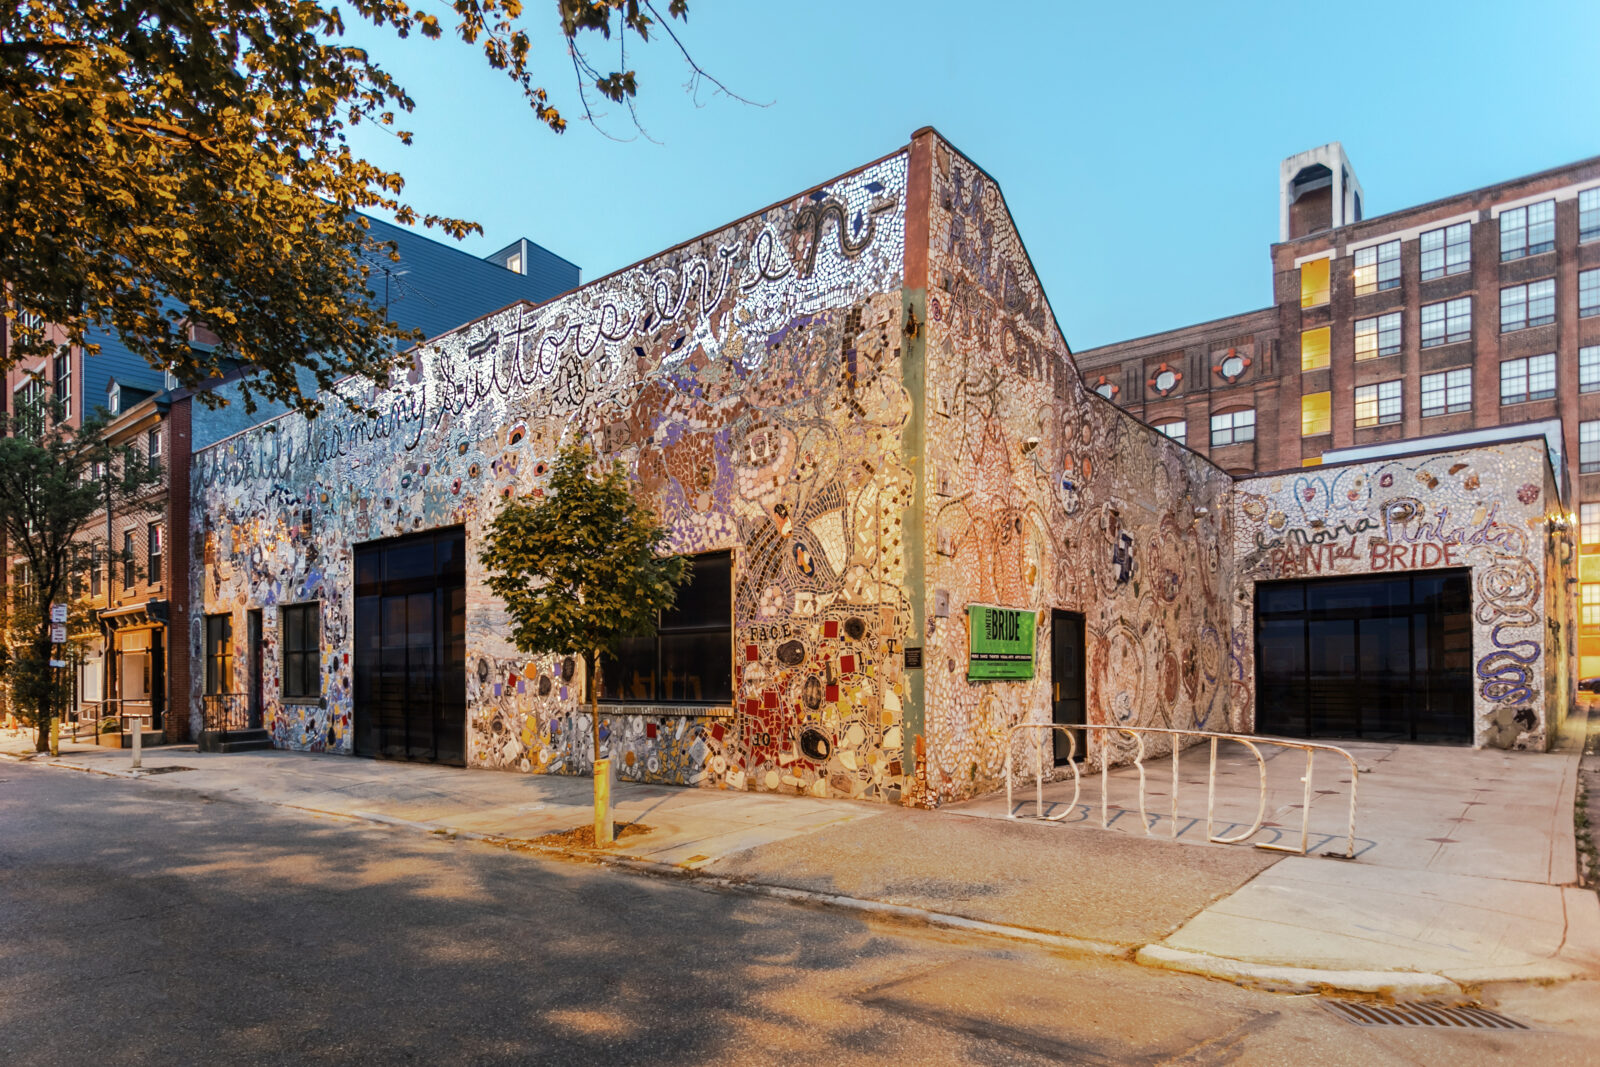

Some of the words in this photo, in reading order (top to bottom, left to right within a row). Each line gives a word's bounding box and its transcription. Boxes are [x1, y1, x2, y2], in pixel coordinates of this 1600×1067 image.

[350, 384, 426, 451] many
[1371, 541, 1463, 571] BRIDE
[750, 623, 792, 641] FACE
[992, 609, 1021, 642] BRIDE
